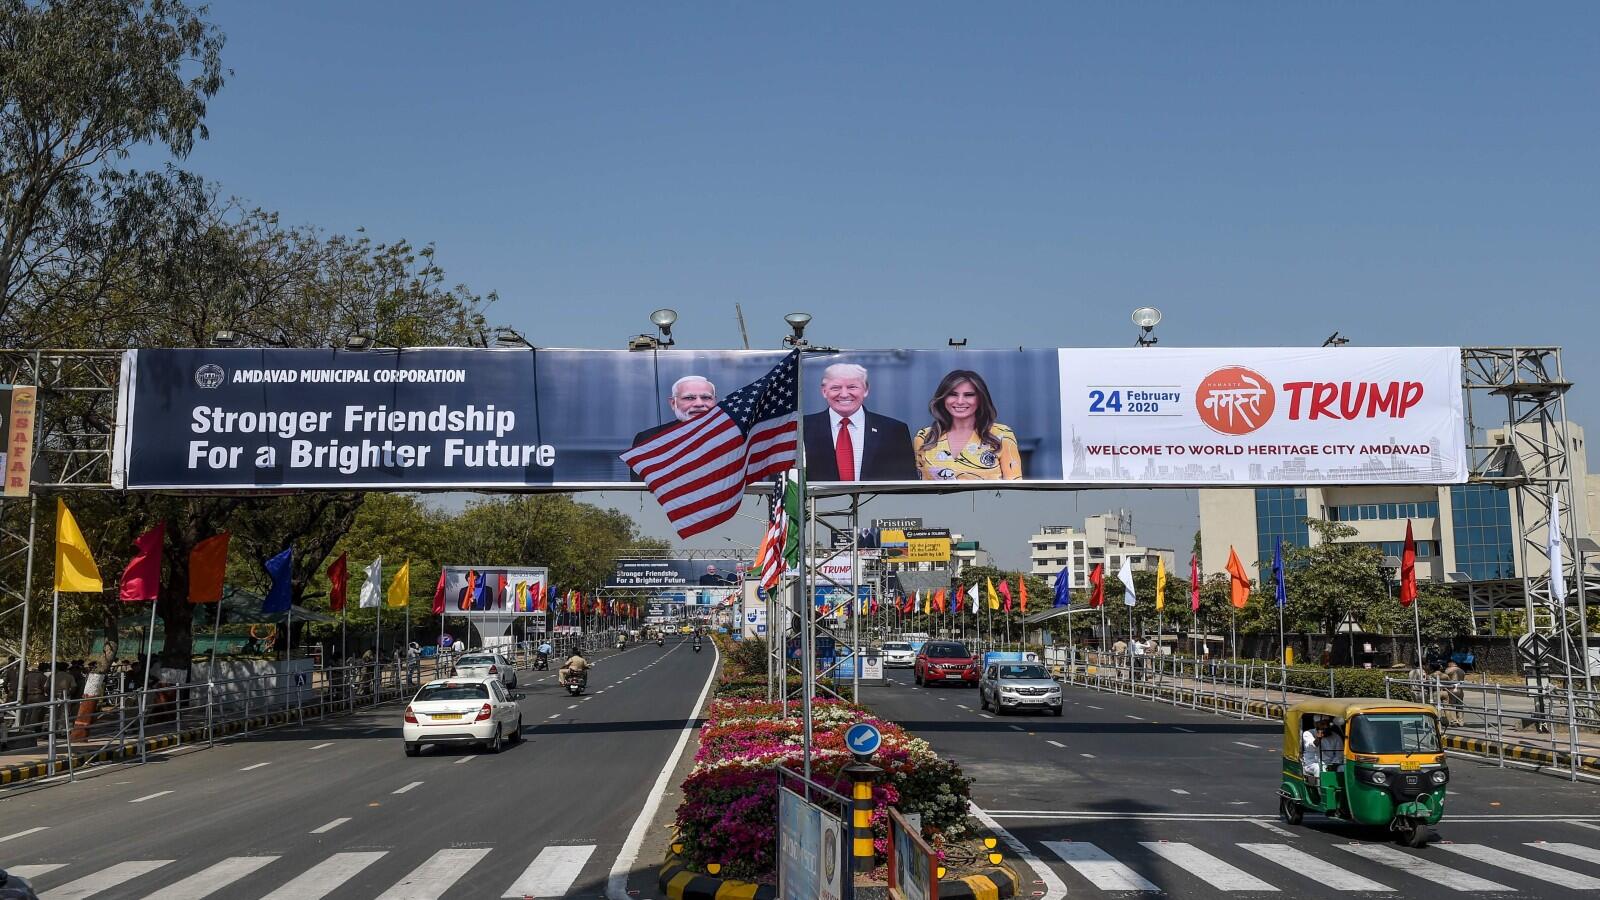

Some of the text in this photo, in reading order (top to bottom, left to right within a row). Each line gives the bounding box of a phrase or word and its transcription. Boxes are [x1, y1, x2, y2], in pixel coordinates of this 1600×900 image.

[233, 369, 466, 382] AMDAVAD MUNICIPAL CORPORATION
[1089, 390, 1181, 412] 24 February
[1128, 403, 1159, 412] 2020
[1204, 374, 1267, 428] नमस्ते
[1283, 381, 1424, 420] TRUMP
[191, 405, 515, 438] Stronger Friendship
[10, 418, 28, 488] SAFAR
[188, 439, 555, 474] For a Brighter Future
[1087, 444, 1430, 455] WELCOME TO WORLD HERITAGE CITY AMDAVAD
[876, 519, 917, 527] Pristine
[823, 565, 852, 574] TRUMP
